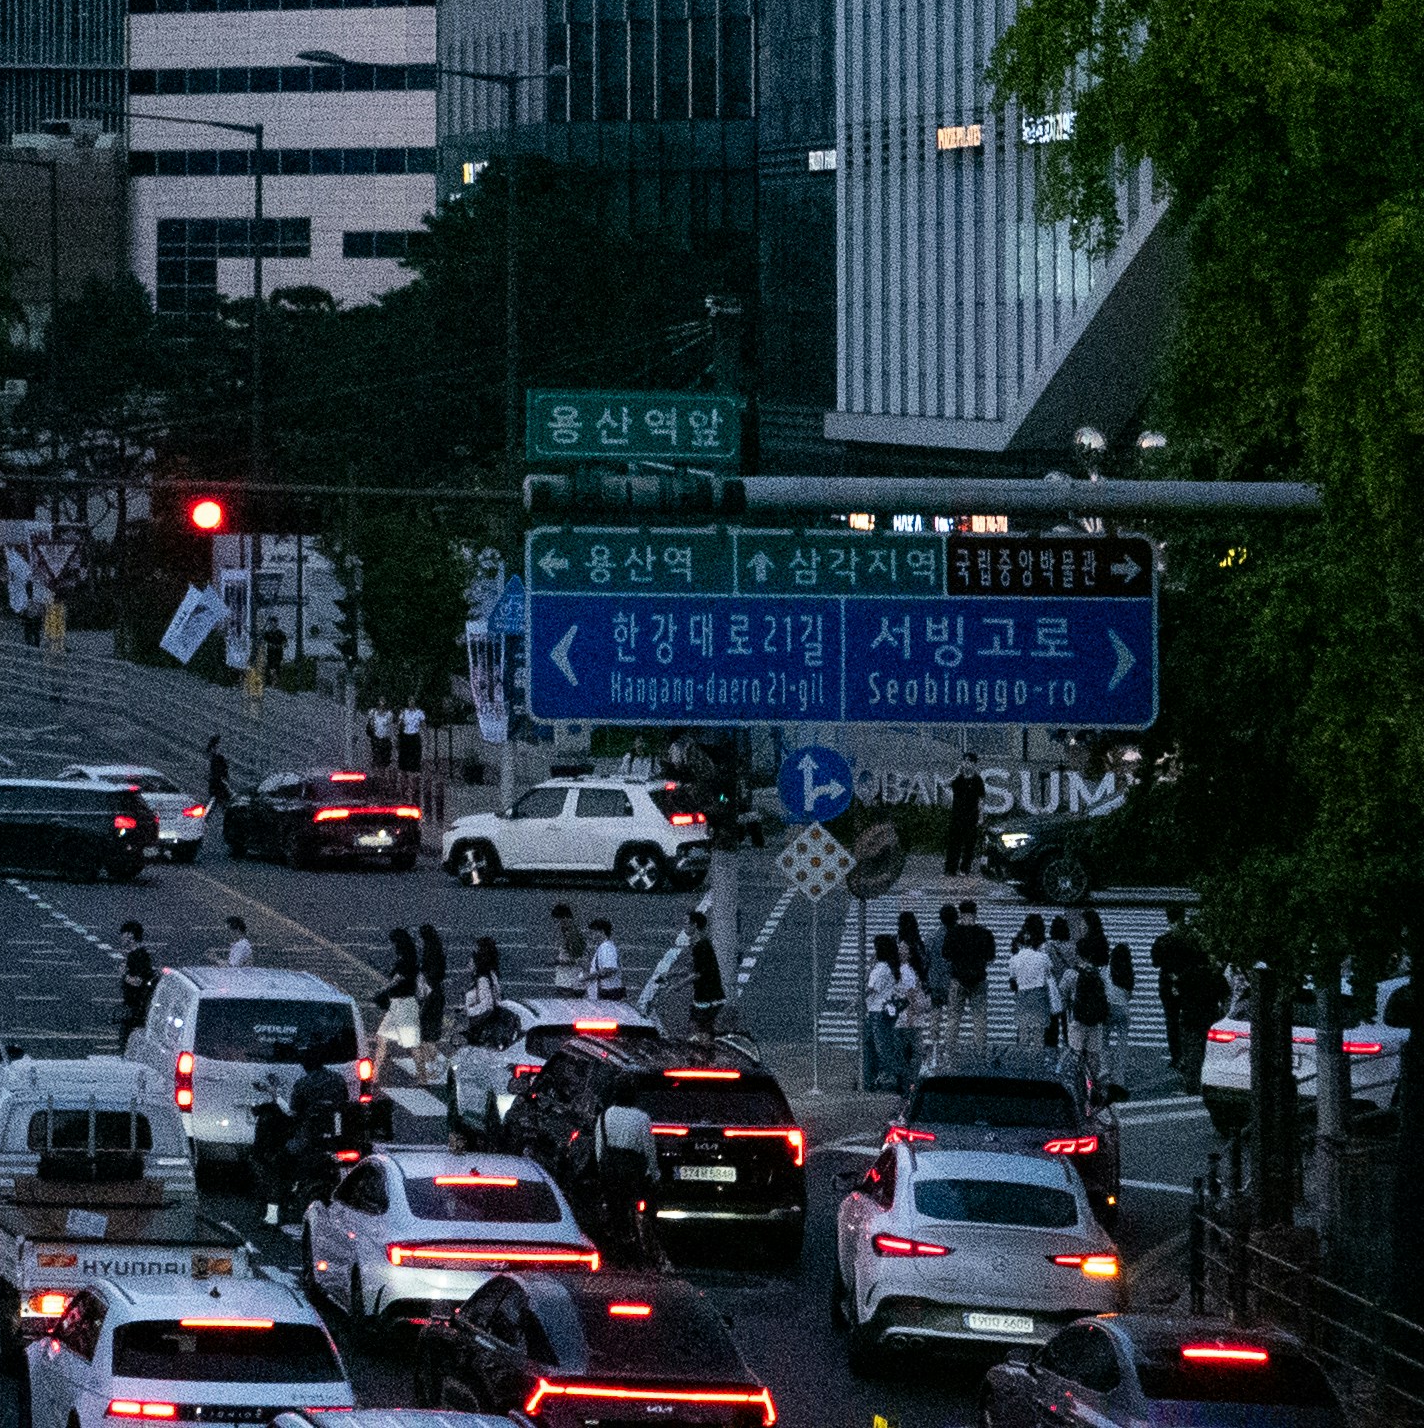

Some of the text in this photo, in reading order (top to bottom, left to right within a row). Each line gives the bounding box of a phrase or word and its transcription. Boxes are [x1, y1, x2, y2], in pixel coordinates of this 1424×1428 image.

[547, 407, 723, 448] 용산역앞
[584, 545, 693, 583] 용산역
[788, 545, 938, 585] 삼각지역
[955, 549, 1098, 587] 국립중앙박물관
[869, 614, 1074, 667] 서빙고로
[611, 673, 825, 711] Hangang-daero 21-gil
[868, 673, 1077, 713] Seobinggo-ro
[82, 1259, 186, 1276] HYUNDAI
